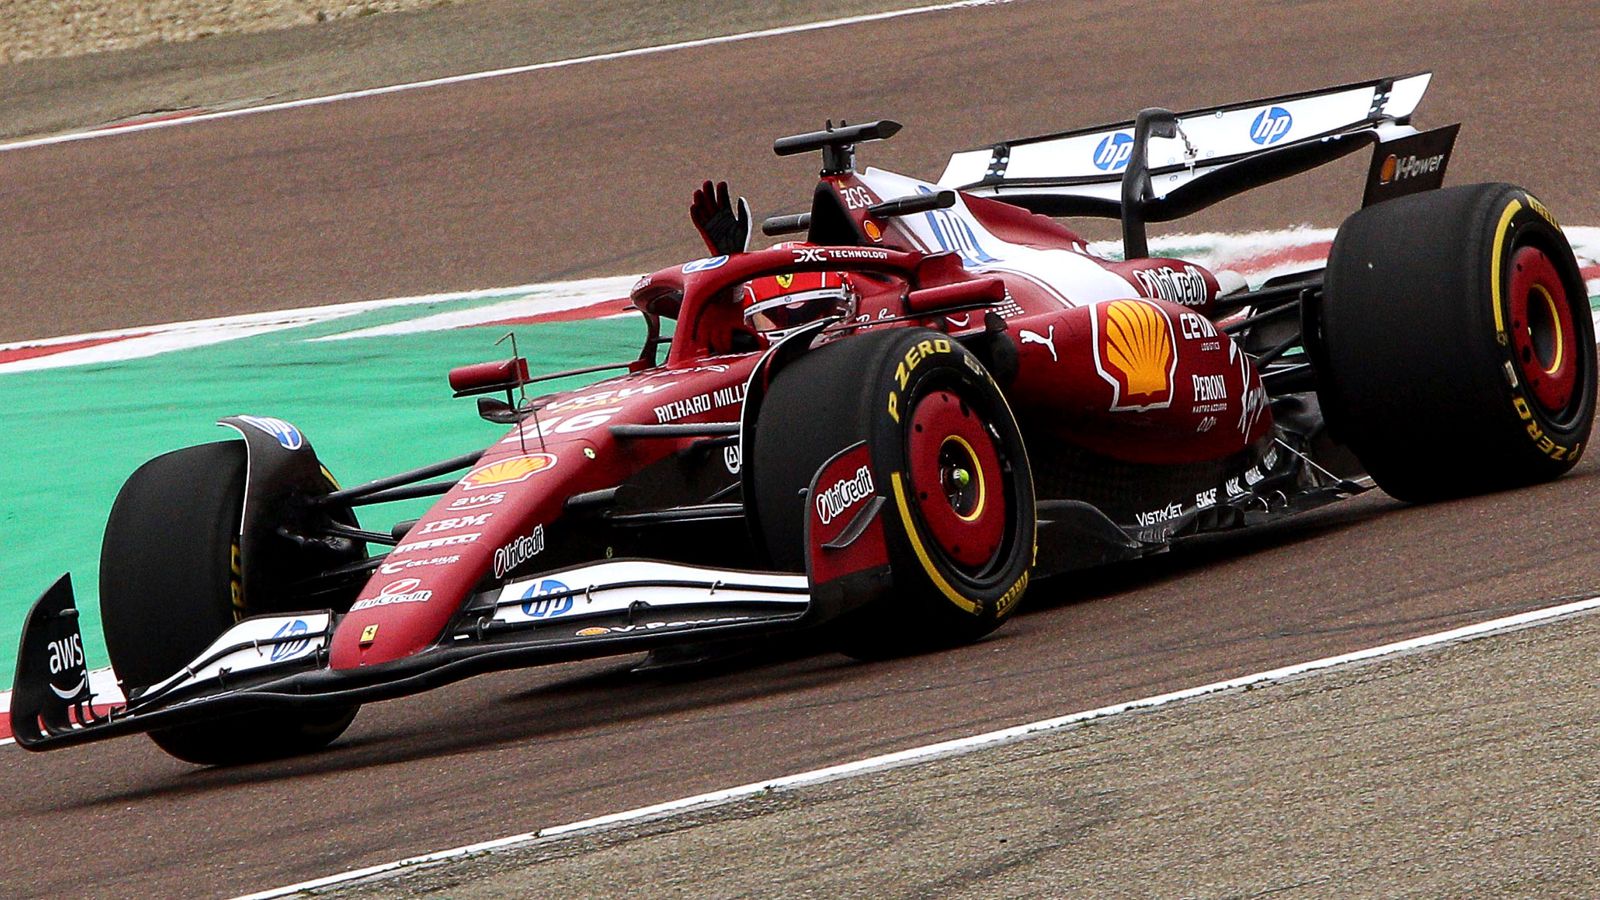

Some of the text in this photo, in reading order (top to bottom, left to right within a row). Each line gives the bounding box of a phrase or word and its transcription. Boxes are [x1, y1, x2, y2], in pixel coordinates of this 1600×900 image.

[1250, 106, 1293, 145] hp
[1093, 132, 1136, 171] hp
[1395, 154, 1444, 181] V-Power
[840, 186, 874, 210] ZCG
[792, 249, 888, 263] DXC TECHNOLOGY
[888, 339, 952, 424] P ZERO
[1191, 374, 1227, 402] PERONI
[500, 407, 624, 444] 16
[653, 394, 711, 424] RICHARD
[1512, 397, 1568, 460] ZERO
[825, 465, 875, 518] UniCredit
[1195, 488, 1217, 509] SKF
[417, 512, 494, 535] IBM
[504, 523, 545, 573] UniCredit
[521, 579, 573, 618] hp
[47, 633, 84, 675] aws
